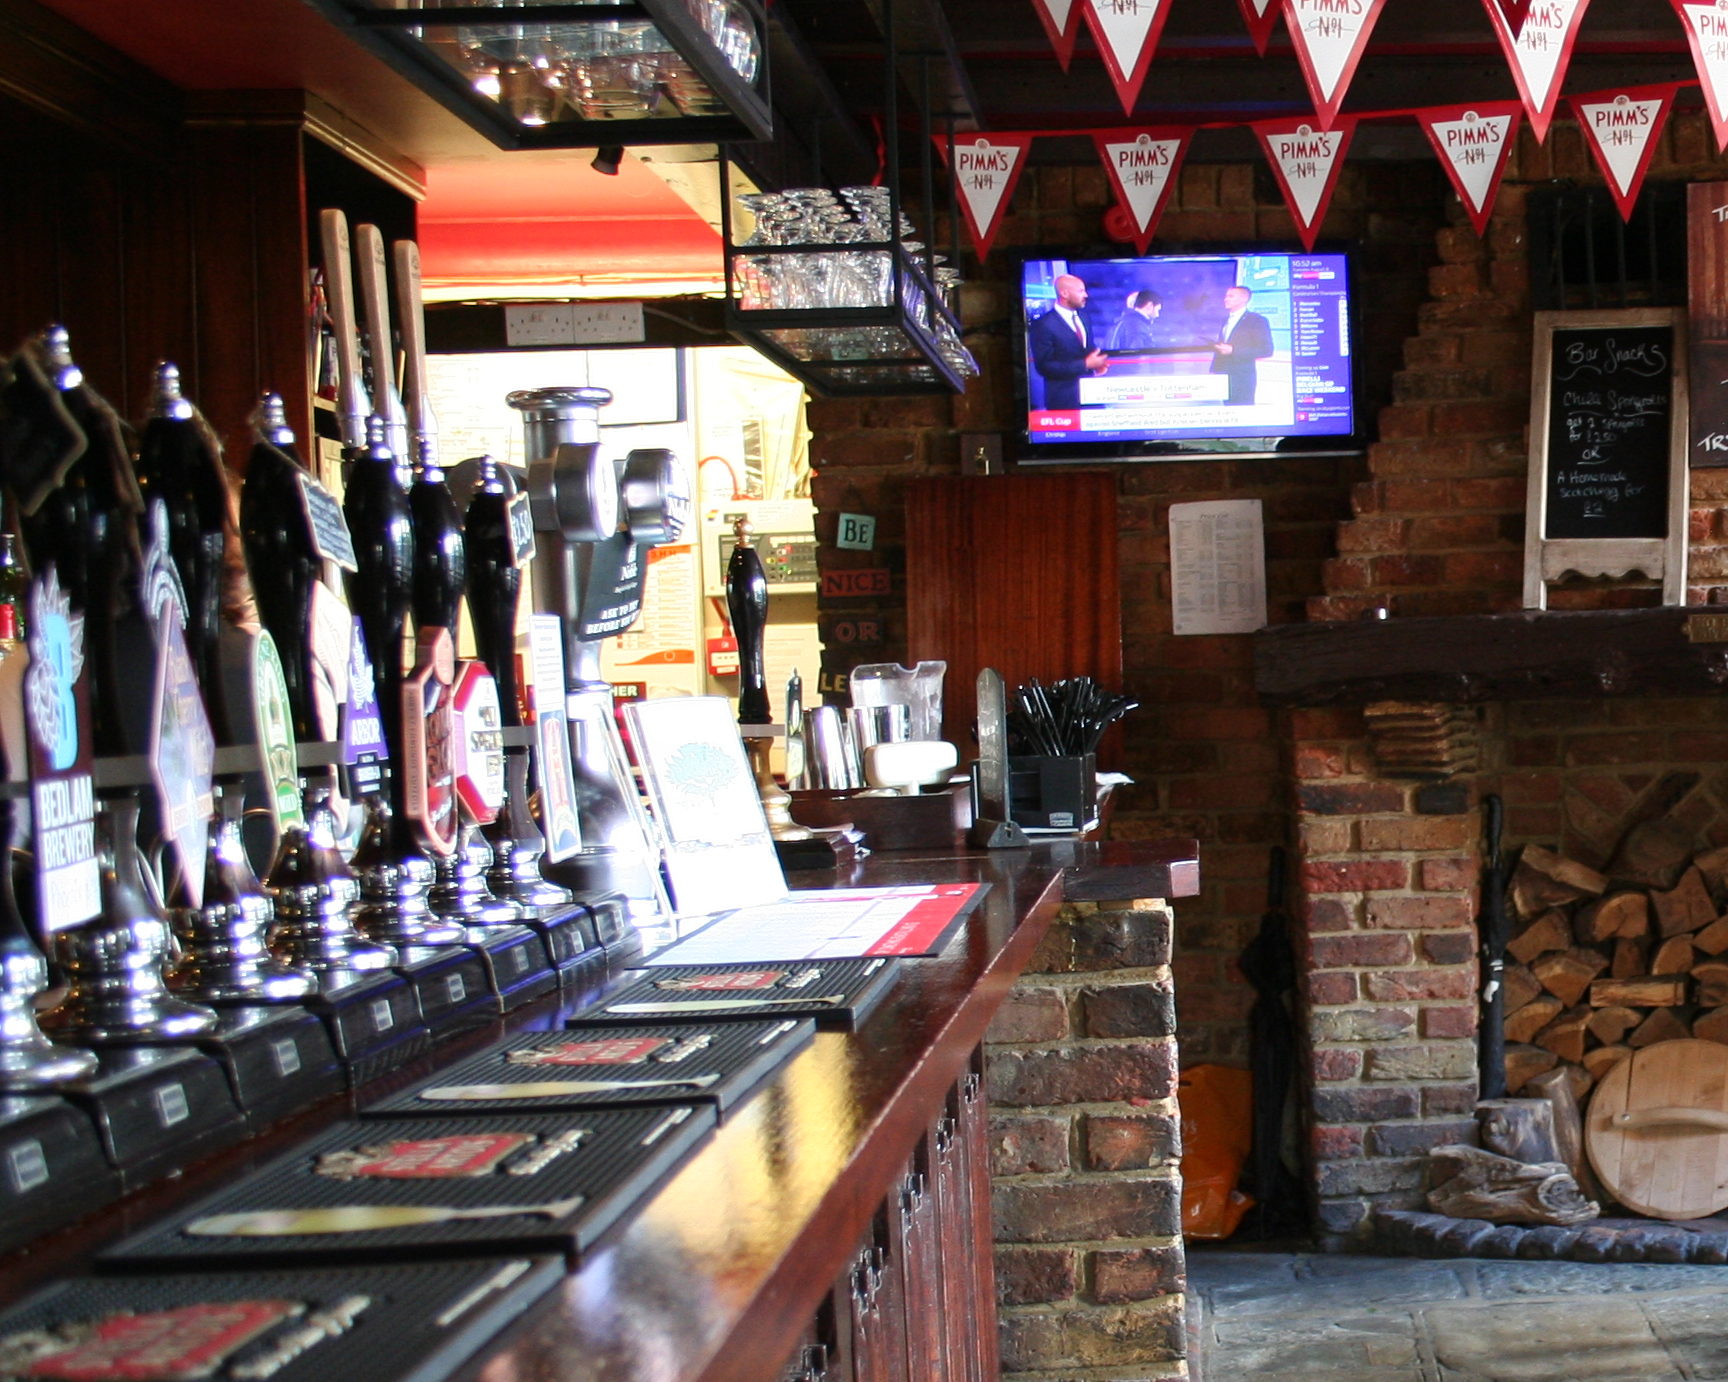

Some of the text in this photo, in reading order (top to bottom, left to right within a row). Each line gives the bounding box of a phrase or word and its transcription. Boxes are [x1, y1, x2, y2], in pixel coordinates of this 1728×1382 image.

[1526, 3, 1564, 30] MM'S
[1595, 105, 1649, 128] PIMM'S
[1446, 121, 1500, 148] PIMM'S
[1118, 145, 1169, 169] PIMM'S
[1281, 137, 1331, 160] PIMM'S
[959, 150, 1009, 172] PIMM'S
[1566, 342, 1599, 364] Bar
[1040, 417, 1072, 426] EFL Cup
[844, 519, 869, 543] BE
[826, 572, 889, 593] NICE
[835, 621, 880, 643] OR
[351, 717, 382, 746] ARBOR
[40, 775, 94, 830] BEDLAM
[43, 822, 95, 871] BREWERY
